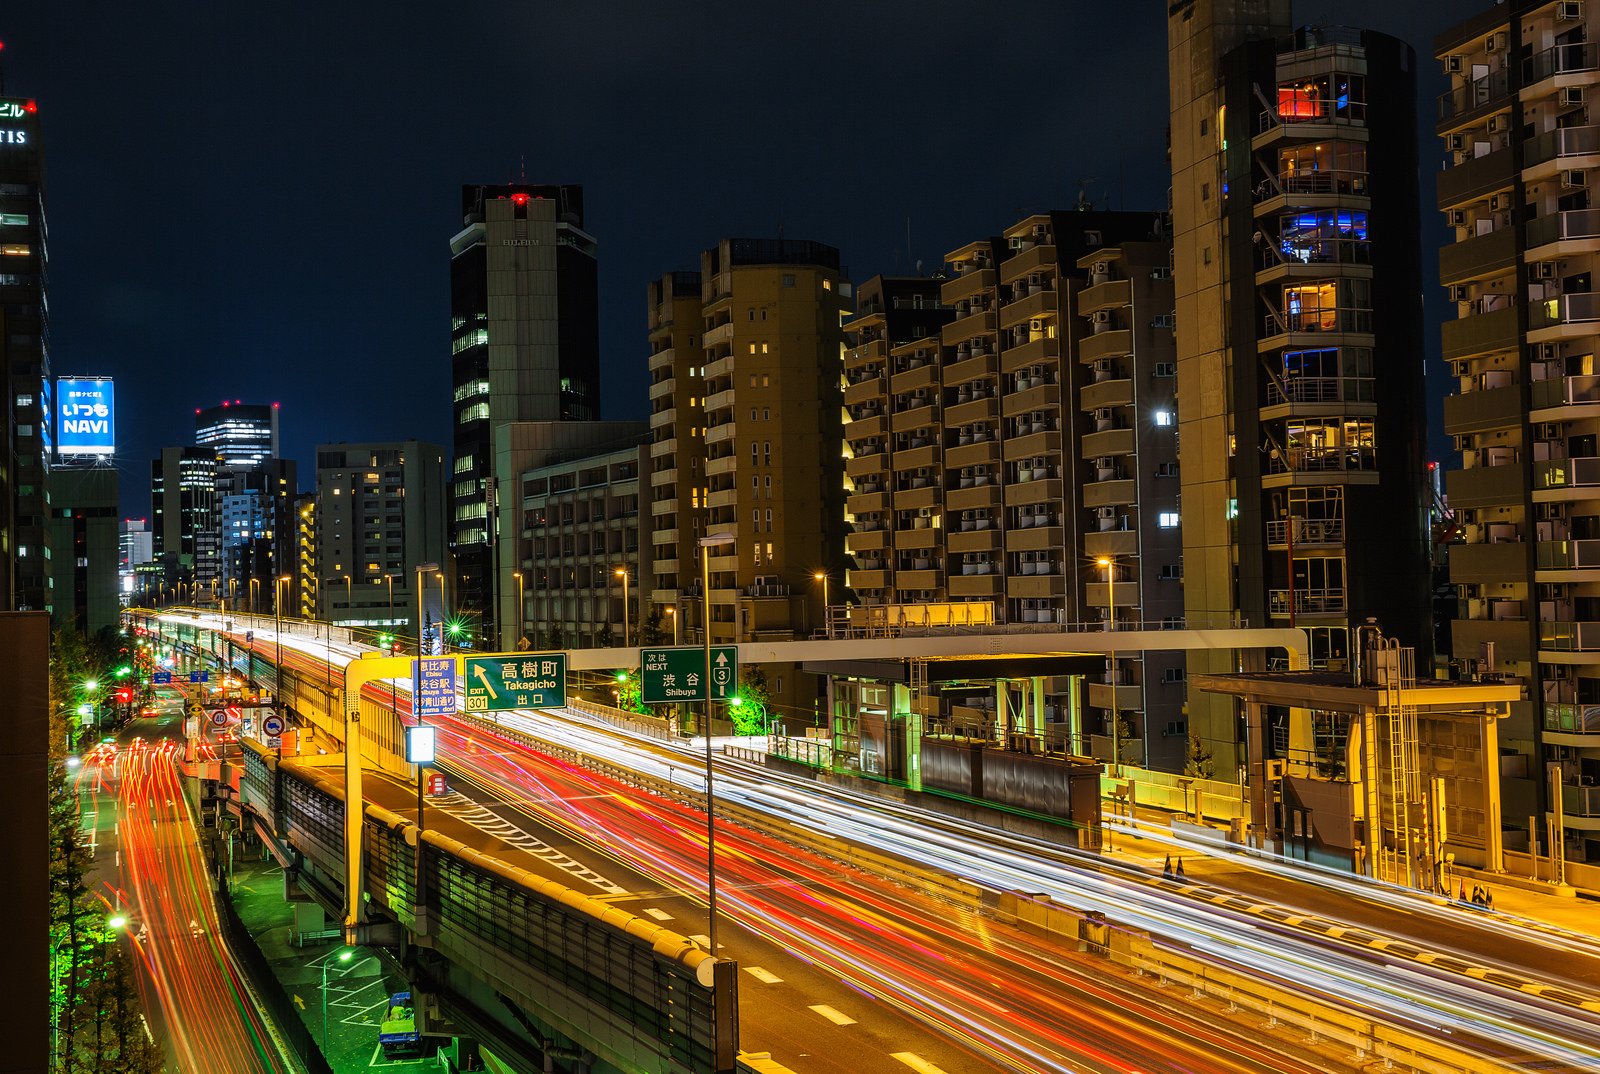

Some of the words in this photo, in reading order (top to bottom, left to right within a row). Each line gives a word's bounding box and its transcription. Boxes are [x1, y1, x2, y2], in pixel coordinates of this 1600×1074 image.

[63, 403, 109, 417] いつも
[64, 420, 108, 433] NAVI
[647, 653, 666, 662] 次は
[501, 661, 558, 679] 高樹町
[646, 662, 668, 671] NEXT
[662, 672, 699, 687] 渋谷
[718, 670, 726, 680] 3
[469, 687, 485, 695] EXIT
[503, 679, 556, 691] Takagicho
[665, 688, 696, 697] Shibuya
[469, 697, 487, 709] 301
[517, 693, 543, 706] 出口
